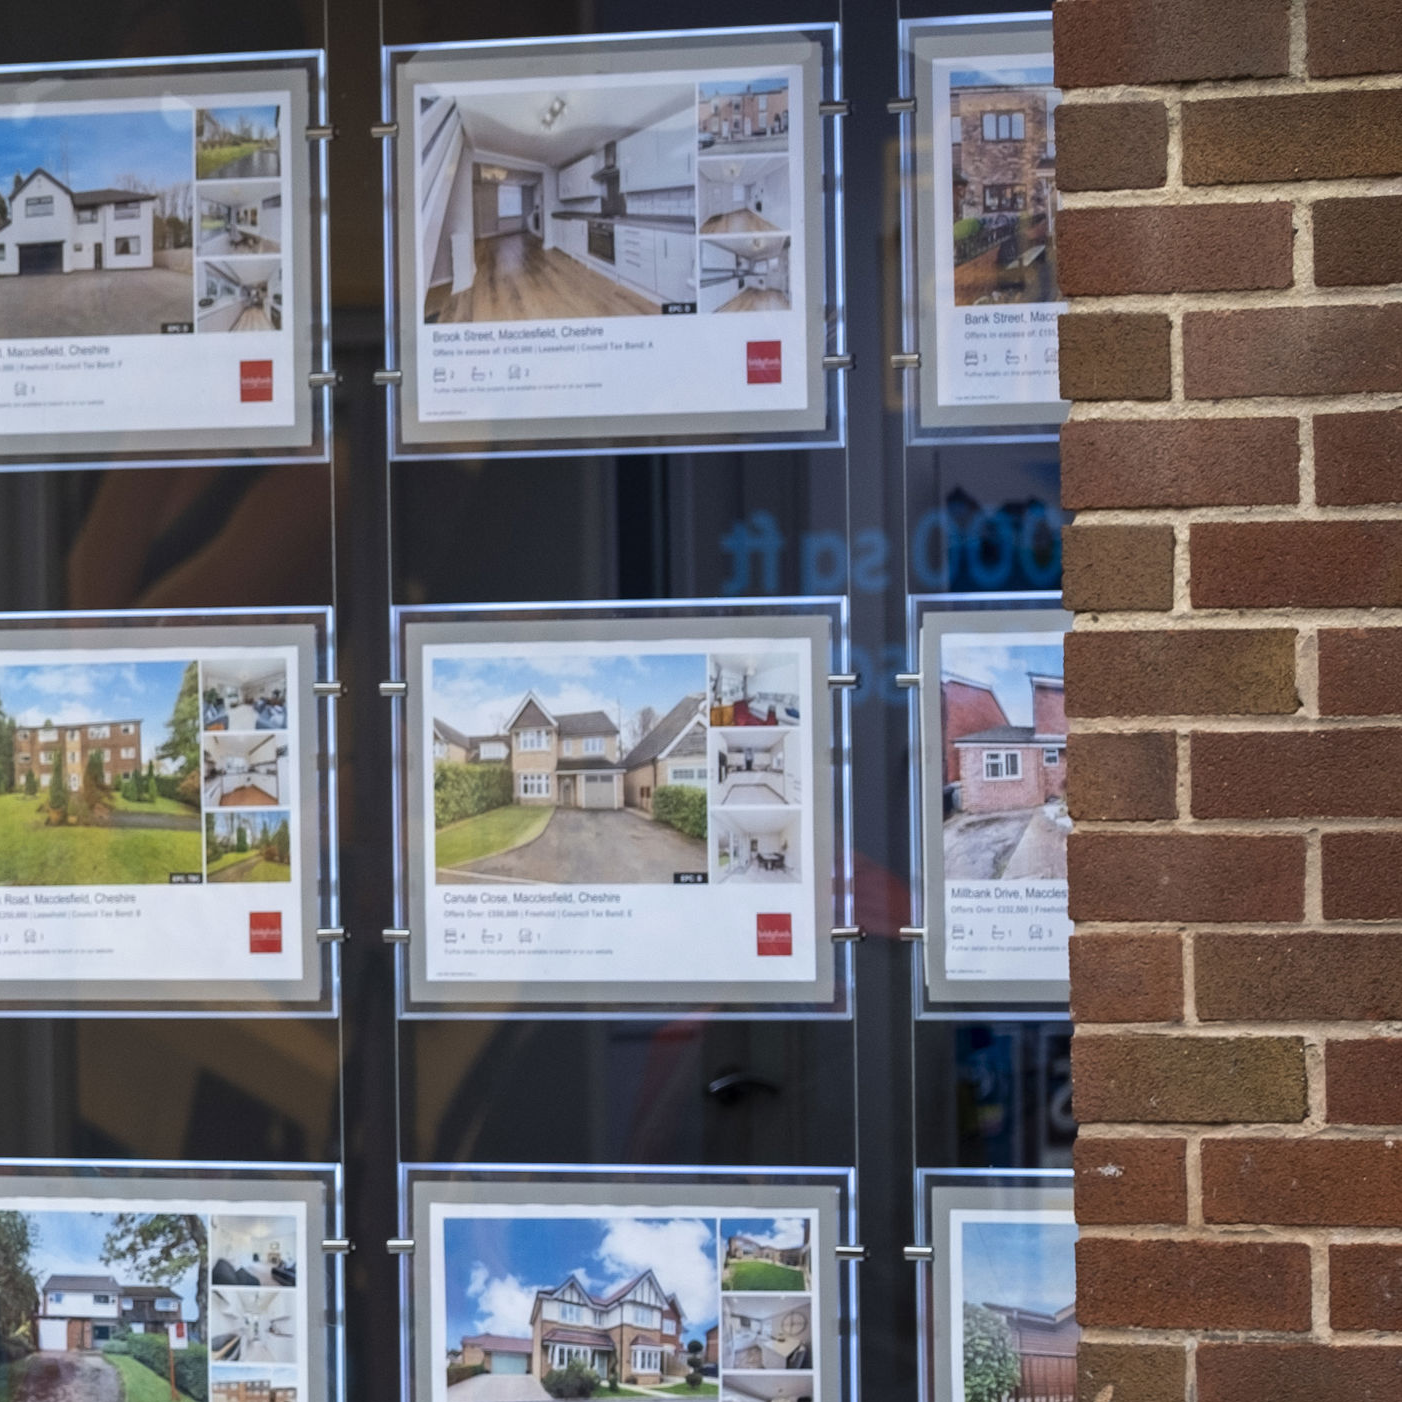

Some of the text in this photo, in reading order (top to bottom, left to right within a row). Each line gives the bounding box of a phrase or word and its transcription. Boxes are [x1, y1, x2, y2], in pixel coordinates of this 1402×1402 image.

[964, 311, 1058, 325] Bank Street, Macc
[433, 327, 604, 343] Brook Street, Macclesfield, Cheshire
[68, 345, 110, 355] Cheshire
[94, 893, 136, 904] Cheshire
[444, 892, 620, 906] Canute Close, Macclesfield, Cheshire
[950, 887, 1068, 901] Millbank Drive, Maccles
